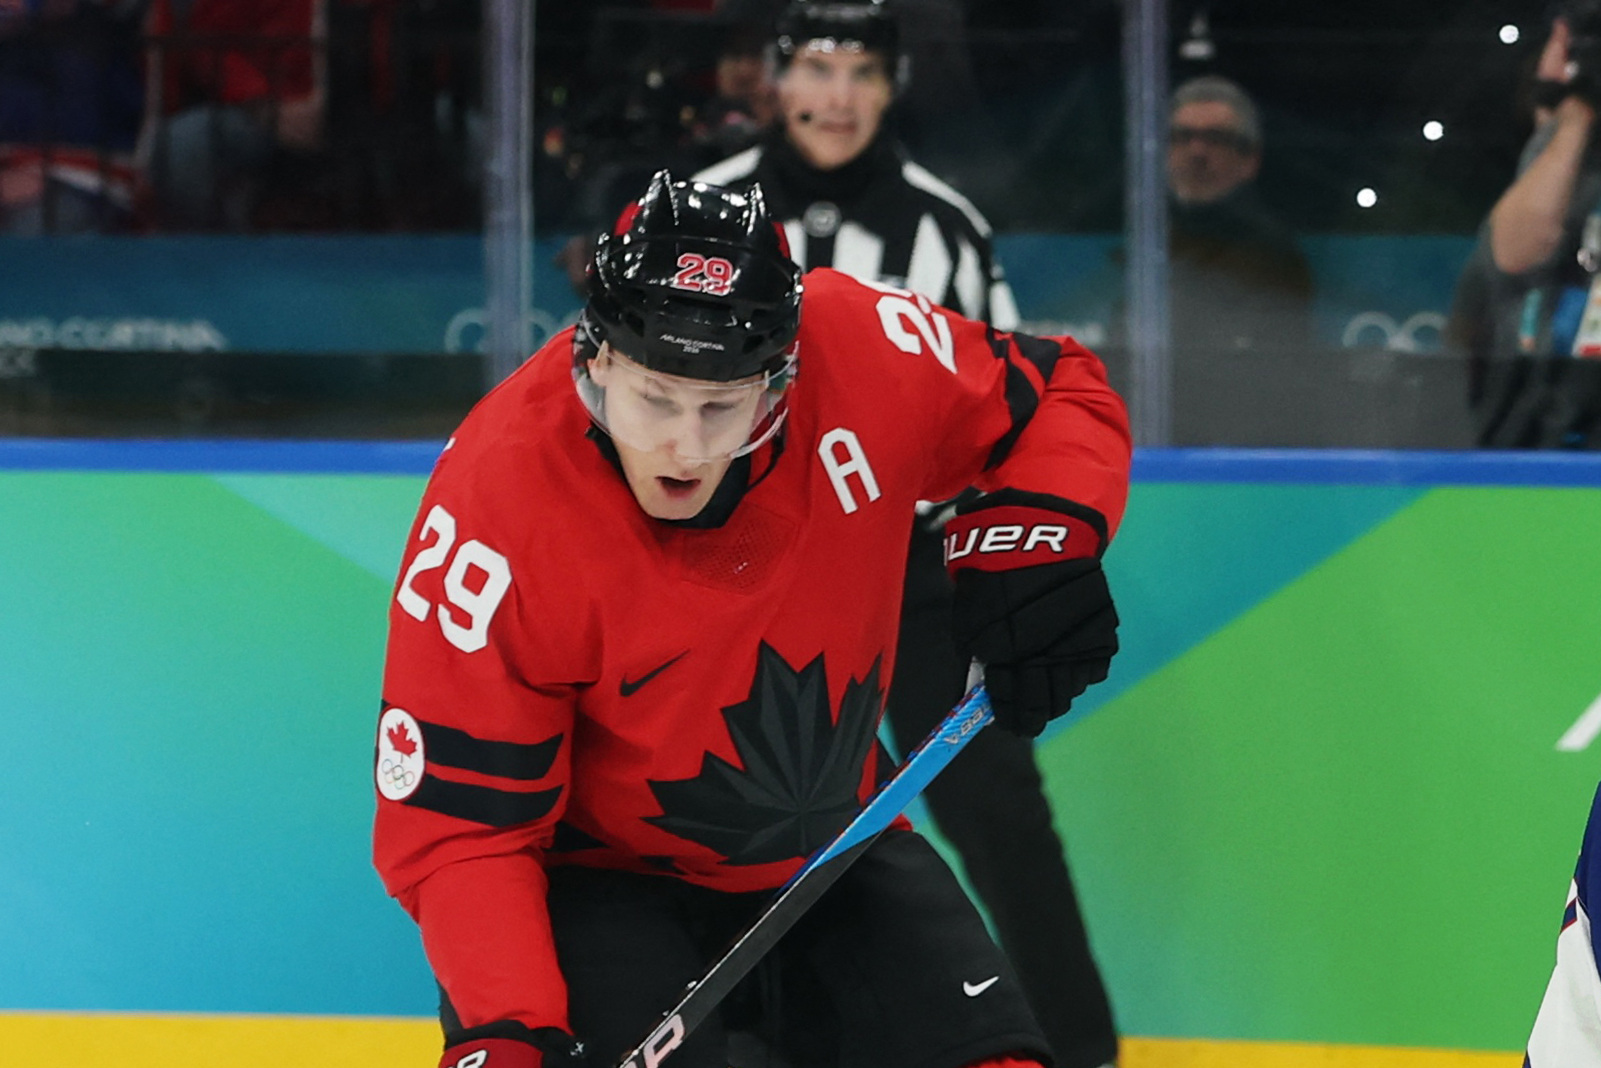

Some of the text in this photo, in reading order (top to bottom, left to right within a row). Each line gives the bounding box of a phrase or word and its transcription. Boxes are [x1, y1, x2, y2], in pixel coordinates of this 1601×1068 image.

[669, 252, 734, 296] 29
[817, 427, 882, 513] A
[396, 504, 513, 654] 29
